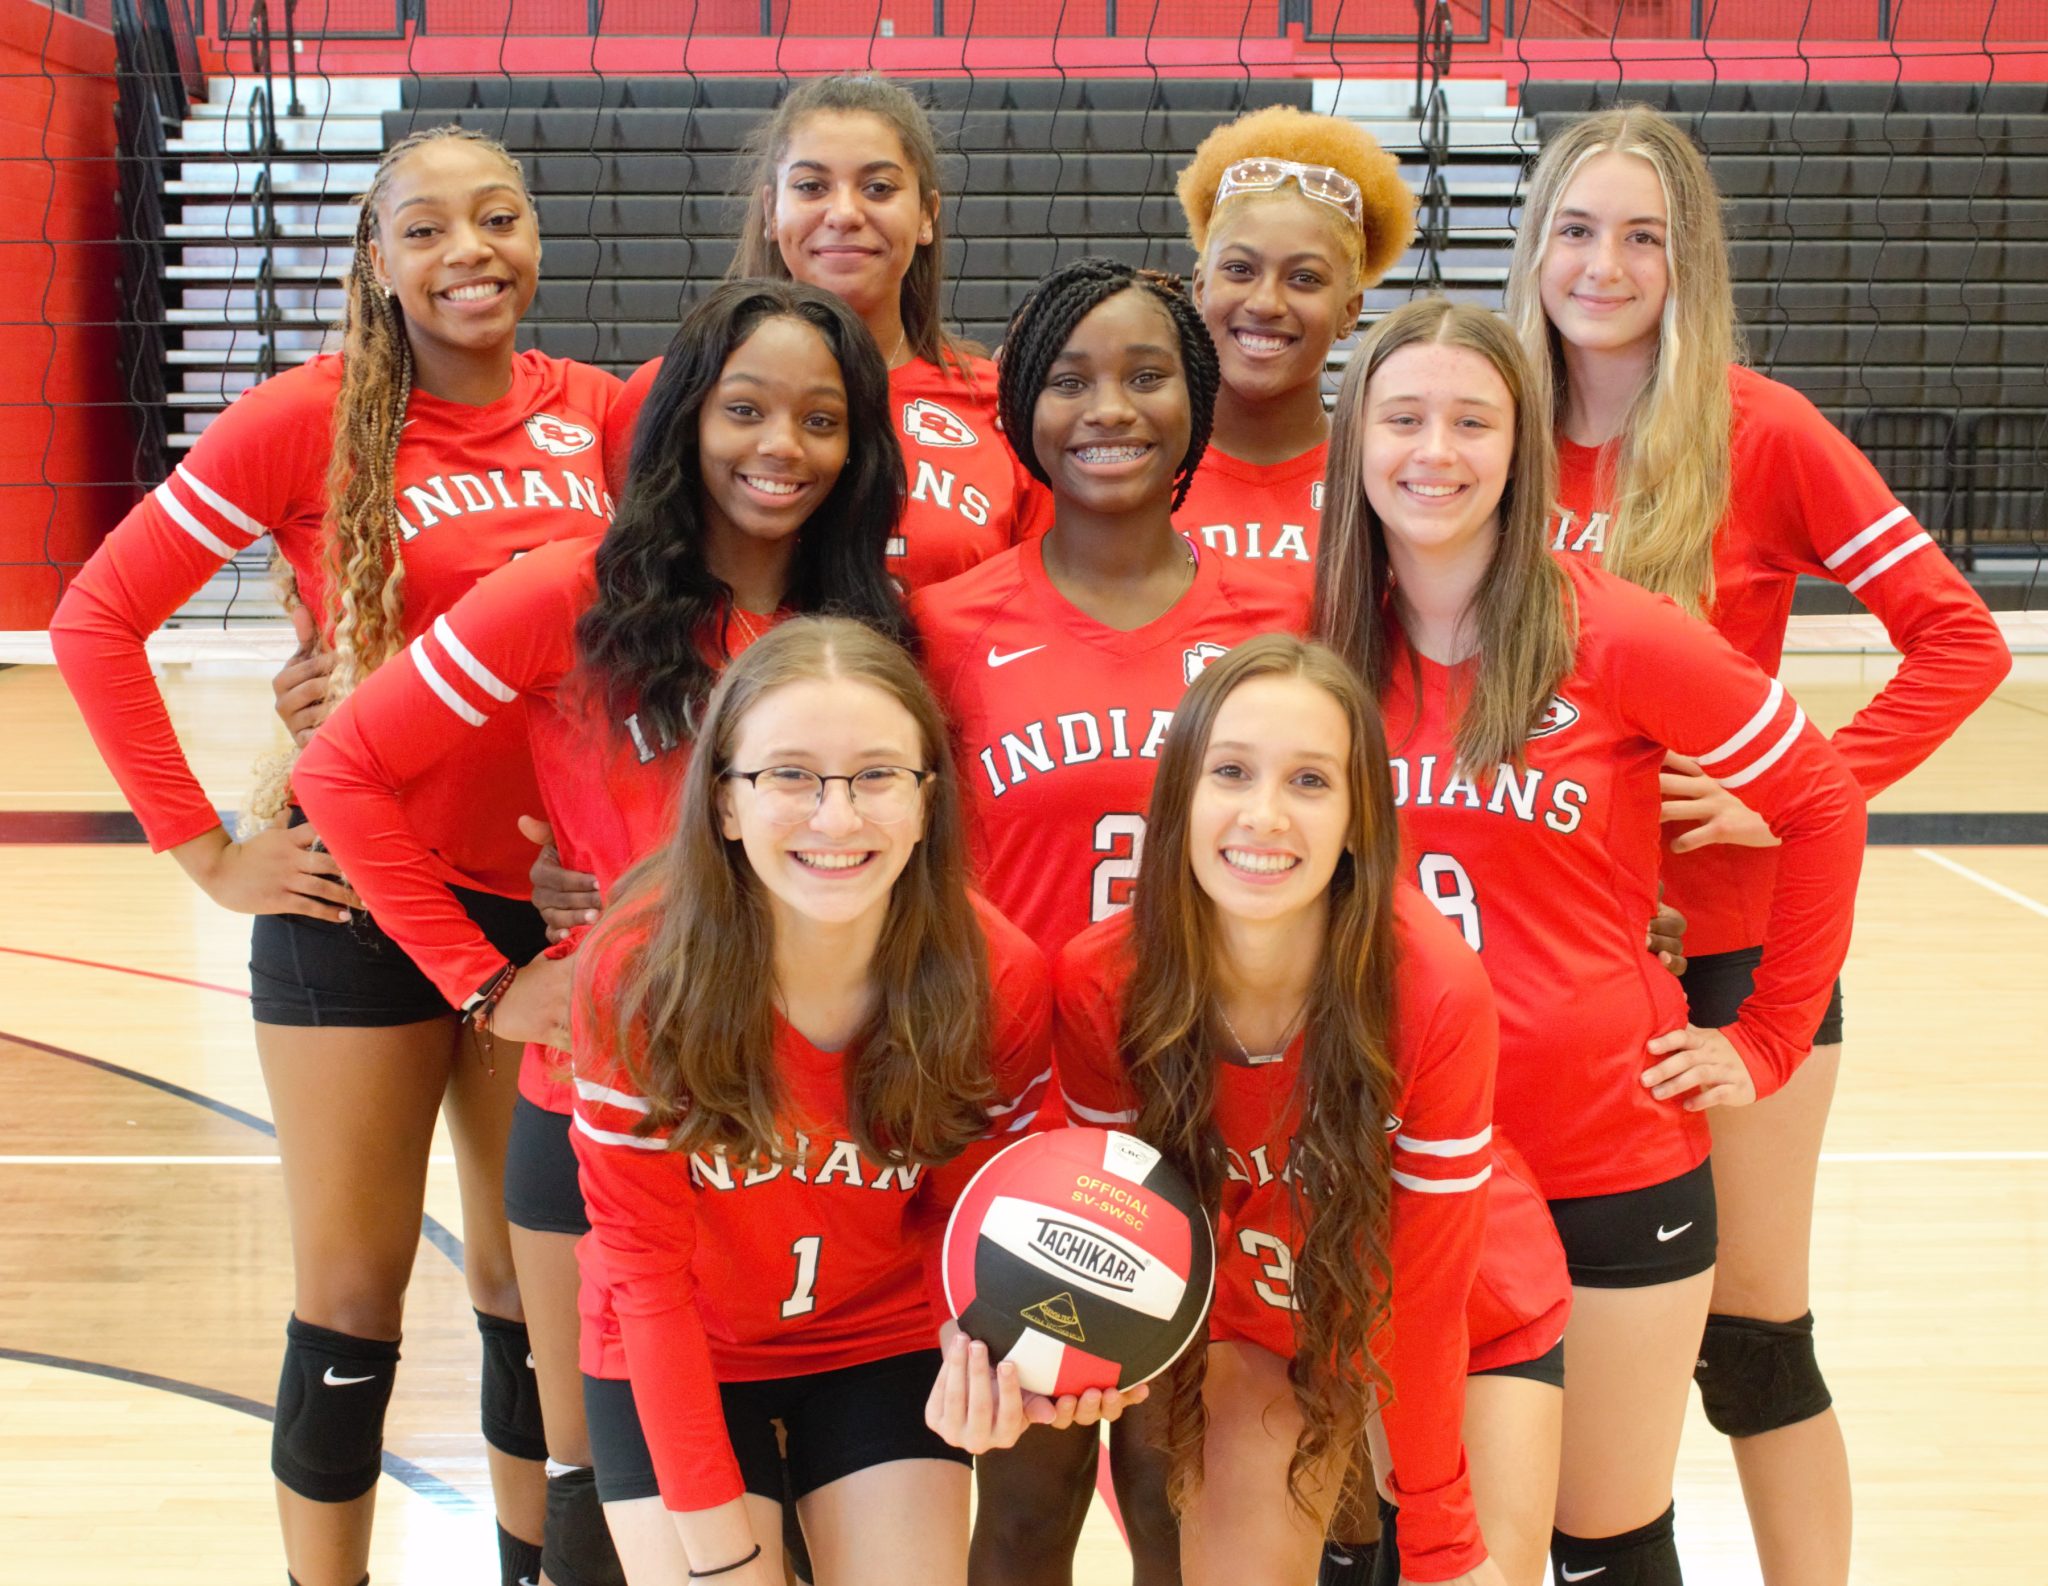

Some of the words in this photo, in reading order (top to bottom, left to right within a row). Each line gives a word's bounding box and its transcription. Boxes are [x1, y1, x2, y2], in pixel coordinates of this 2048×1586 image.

[979, 707, 1176, 798] INDIA
[1089, 811, 1148, 924] 2
[1071, 1190, 1145, 1232] SV-5WSC
[1076, 1175, 1150, 1219] OFFICIAL
[779, 1235, 823, 1321] 1
[1036, 1217, 1138, 1284] TACHIKARA
[1238, 1227, 1305, 1312] 3
